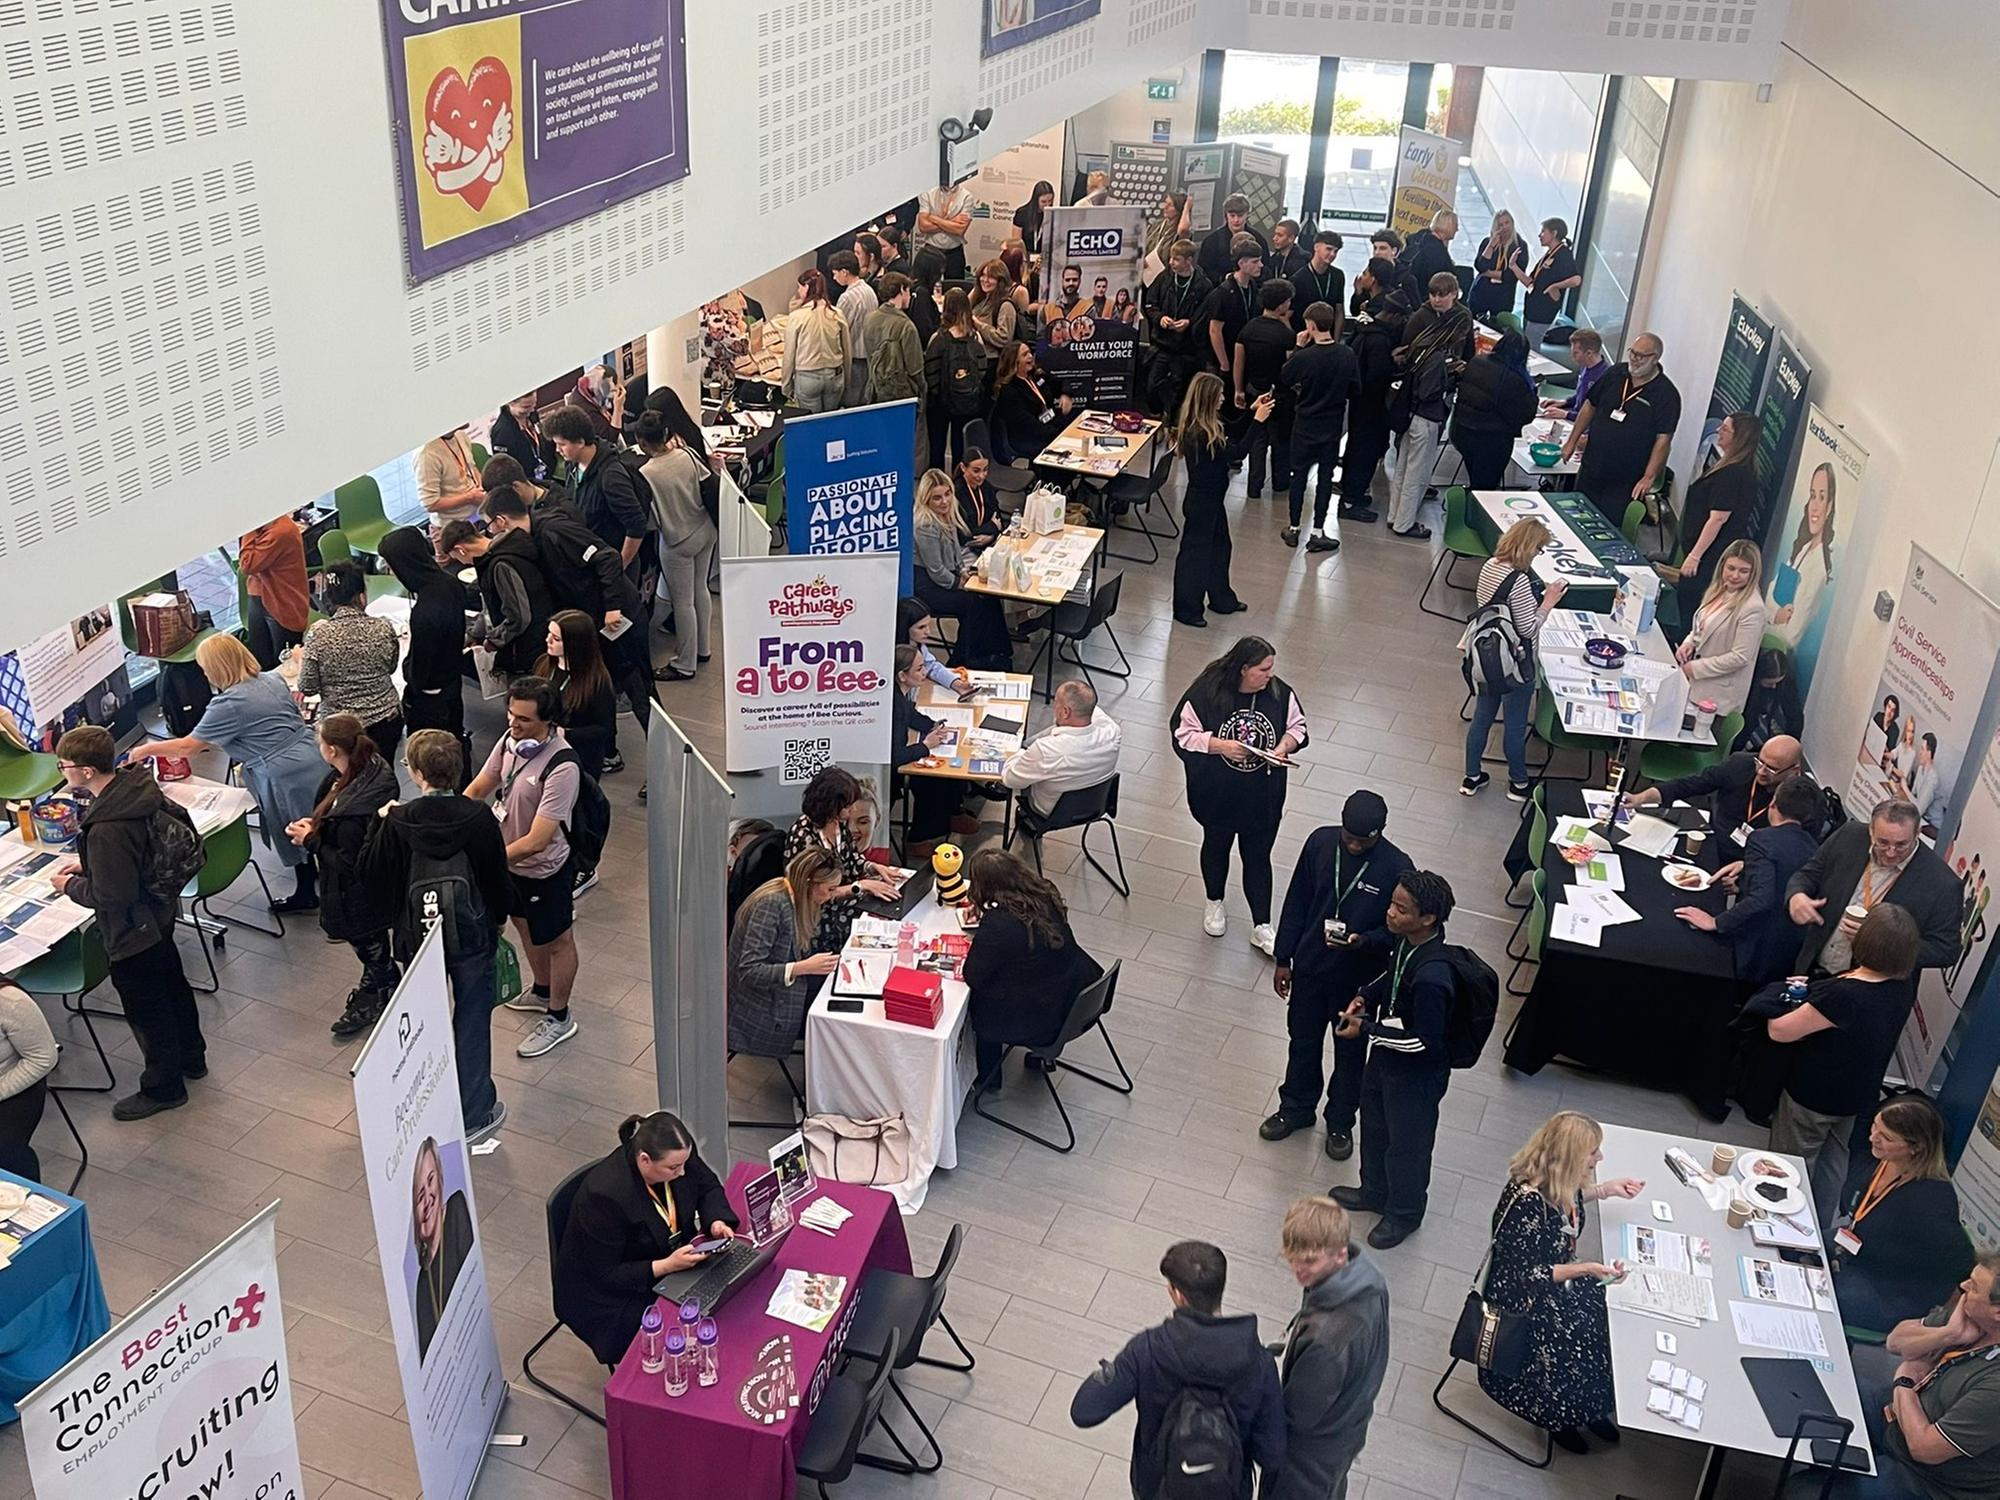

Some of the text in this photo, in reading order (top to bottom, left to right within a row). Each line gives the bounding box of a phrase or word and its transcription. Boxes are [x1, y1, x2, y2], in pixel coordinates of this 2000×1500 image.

[545, 70, 556, 80] We
[557, 66, 570, 77] care
[572, 60, 590, 73] about
[591, 57, 600, 67] the
[601, 48, 630, 63] wellbeing
[631, 43, 639, 54] of
[640, 43, 652, 52] our
[545, 86, 556, 95] our
[586, 73, 596, 83] our
[598, 62, 632, 79] community
[633, 56, 646, 69] and
[545, 81, 659, 125] on trust where we listen, engage with
[570, 88, 596, 102] creating
[595, 86, 603, 95] an
[604, 72, 645, 91] environment
[546, 110, 619, 140] and support each other.
[1404, 141, 1434, 168] Early
[1411, 165, 1451, 193] Careers
[1070, 340, 1134, 351] ELEVATE YOUR
[1737, 315, 1765, 355] Eurokey
[1077, 350, 1132, 360] WORKFORCE
[1778, 357, 1802, 400] Eurokey
[809, 473, 897, 500] PASSIONATE
[810, 487, 897, 524] ABOUT
[810, 510, 898, 543] PLACING
[769, 599, 854, 619] Pathways
[759, 637, 864, 667] From
[1898, 616, 1948, 668] Civil Service
[736, 666, 759, 696] a
[768, 662, 809, 694] to
[1891, 636, 1955, 702] Apprenticeships
[741, 706, 774, 714] Discover
[809, 702, 822, 710] full
[833, 700, 880, 710] possibilities
[768, 713, 781, 721] the
[385, 1044, 450, 1182] Care Professional
[395, 1061, 426, 1133] Become
[49, 1302, 188, 1423] The Best
[55, 1304, 230, 1452] Connection
[748, 1372, 767, 1386] NOW
[62, 1336, 222, 1475] EMPLOYMENT GROUP
[129, 1360, 279, 1500] cruiting
